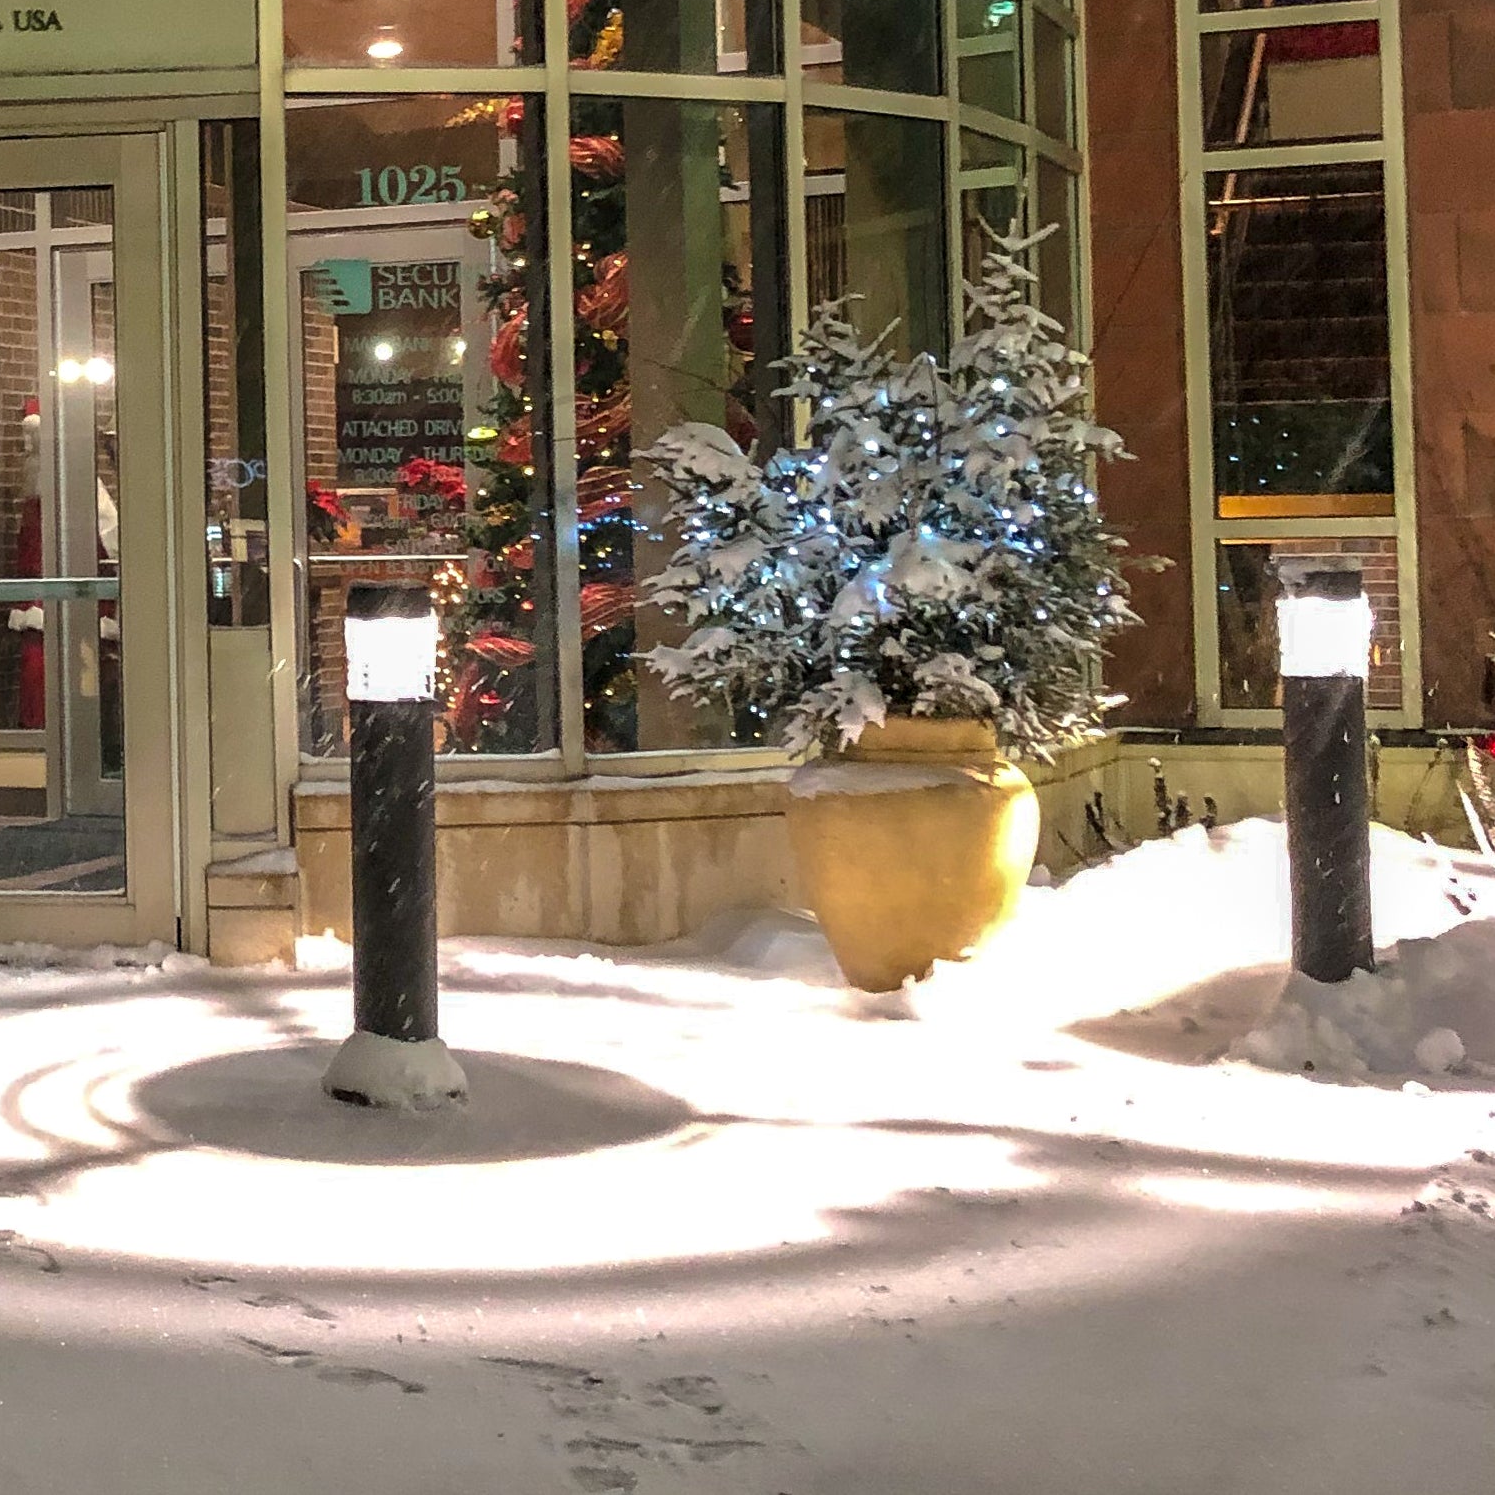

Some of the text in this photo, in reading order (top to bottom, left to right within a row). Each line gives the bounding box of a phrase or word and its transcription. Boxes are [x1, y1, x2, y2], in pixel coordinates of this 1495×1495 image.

[13, 9, 63, 32] USA
[356, 164, 466, 205] 1025
[377, 263, 461, 287] SECU
[378, 287, 460, 310] BANK
[342, 419, 418, 438] ATTACHED
[337, 446, 403, 464] MONDAY
